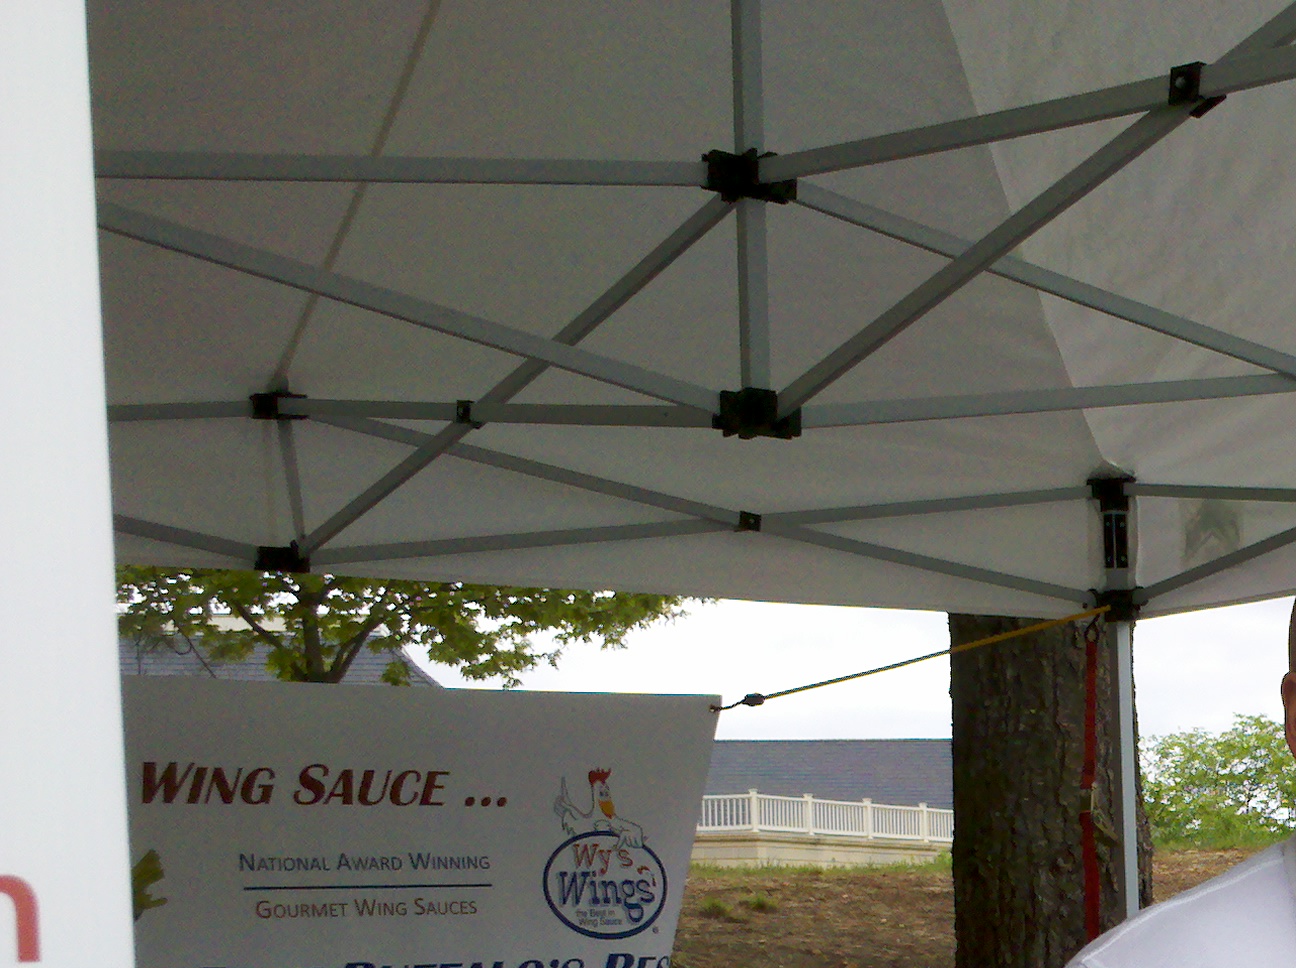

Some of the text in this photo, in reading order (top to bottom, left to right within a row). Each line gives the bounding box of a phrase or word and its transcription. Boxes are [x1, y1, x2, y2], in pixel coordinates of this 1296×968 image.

[141, 761, 276, 806] WING
[294, 763, 450, 806] SAUCE
[239, 852, 491, 872] NATIONAL AWARD WINNING
[572, 843, 634, 875] Wy's
[254, 898, 478, 919] GOURMET WING SAUCES
[557, 870, 656, 923] Wings
